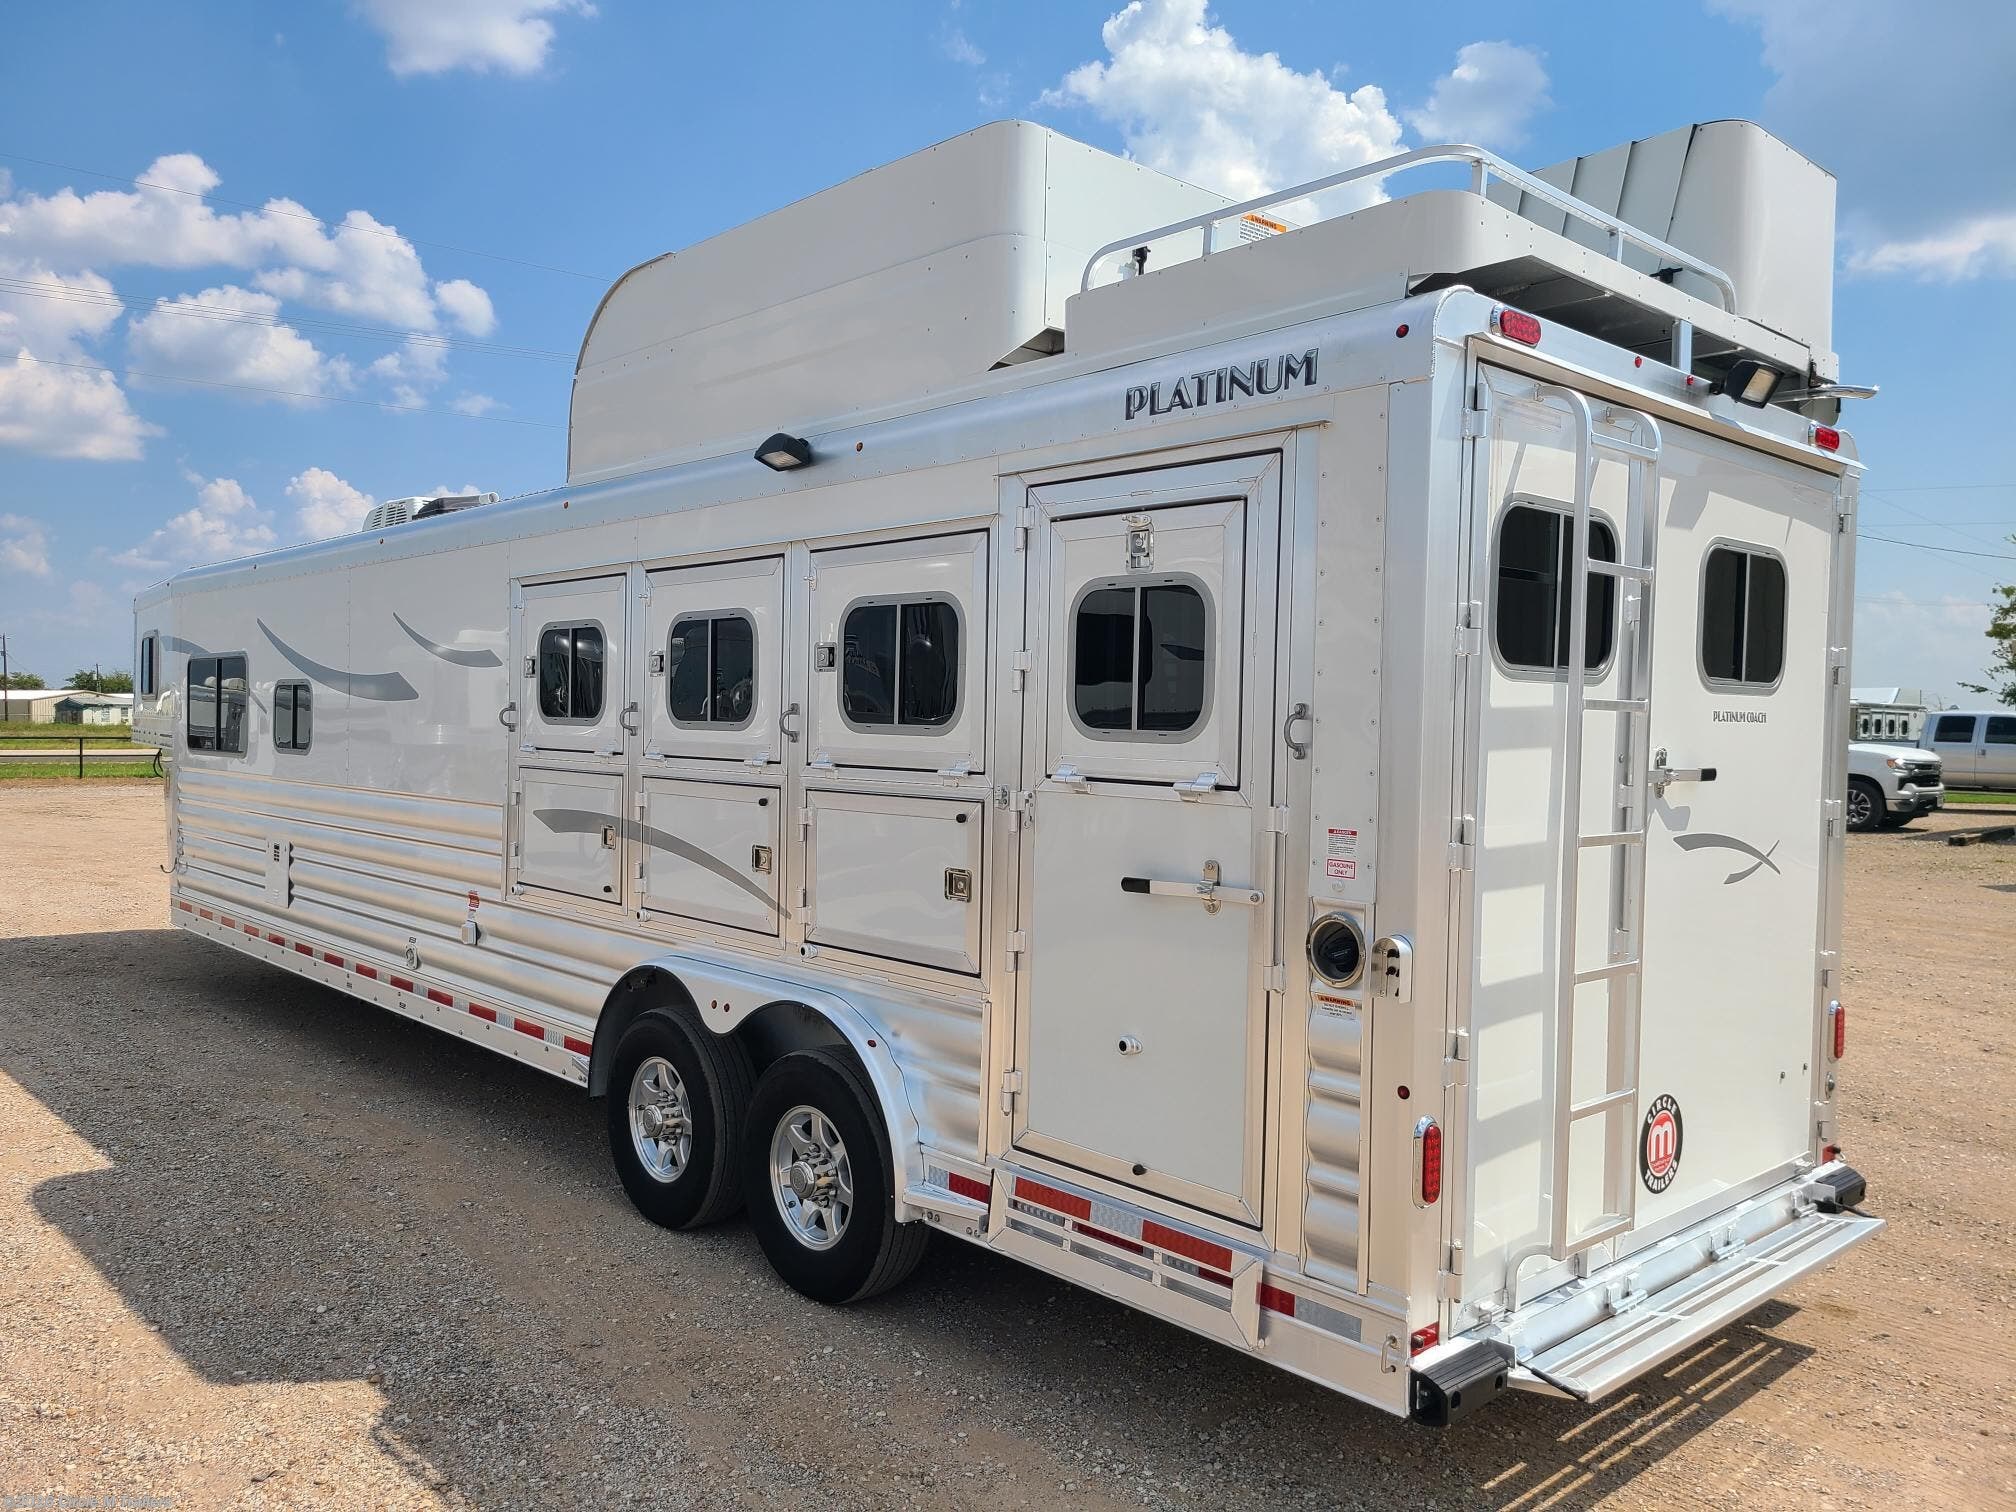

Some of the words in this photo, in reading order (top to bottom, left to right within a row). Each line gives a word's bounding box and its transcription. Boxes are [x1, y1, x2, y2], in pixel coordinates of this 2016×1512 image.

[1125, 347, 1319, 421] PLATINUM
[1712, 710, 1746, 723] PLATINUM
[1746, 711, 1767, 724] COACH
[1329, 862, 1354, 870] GASOLINE
[1647, 1096, 1678, 1124] CIRCLE
[1644, 1160, 1678, 1191] TRAILERS
